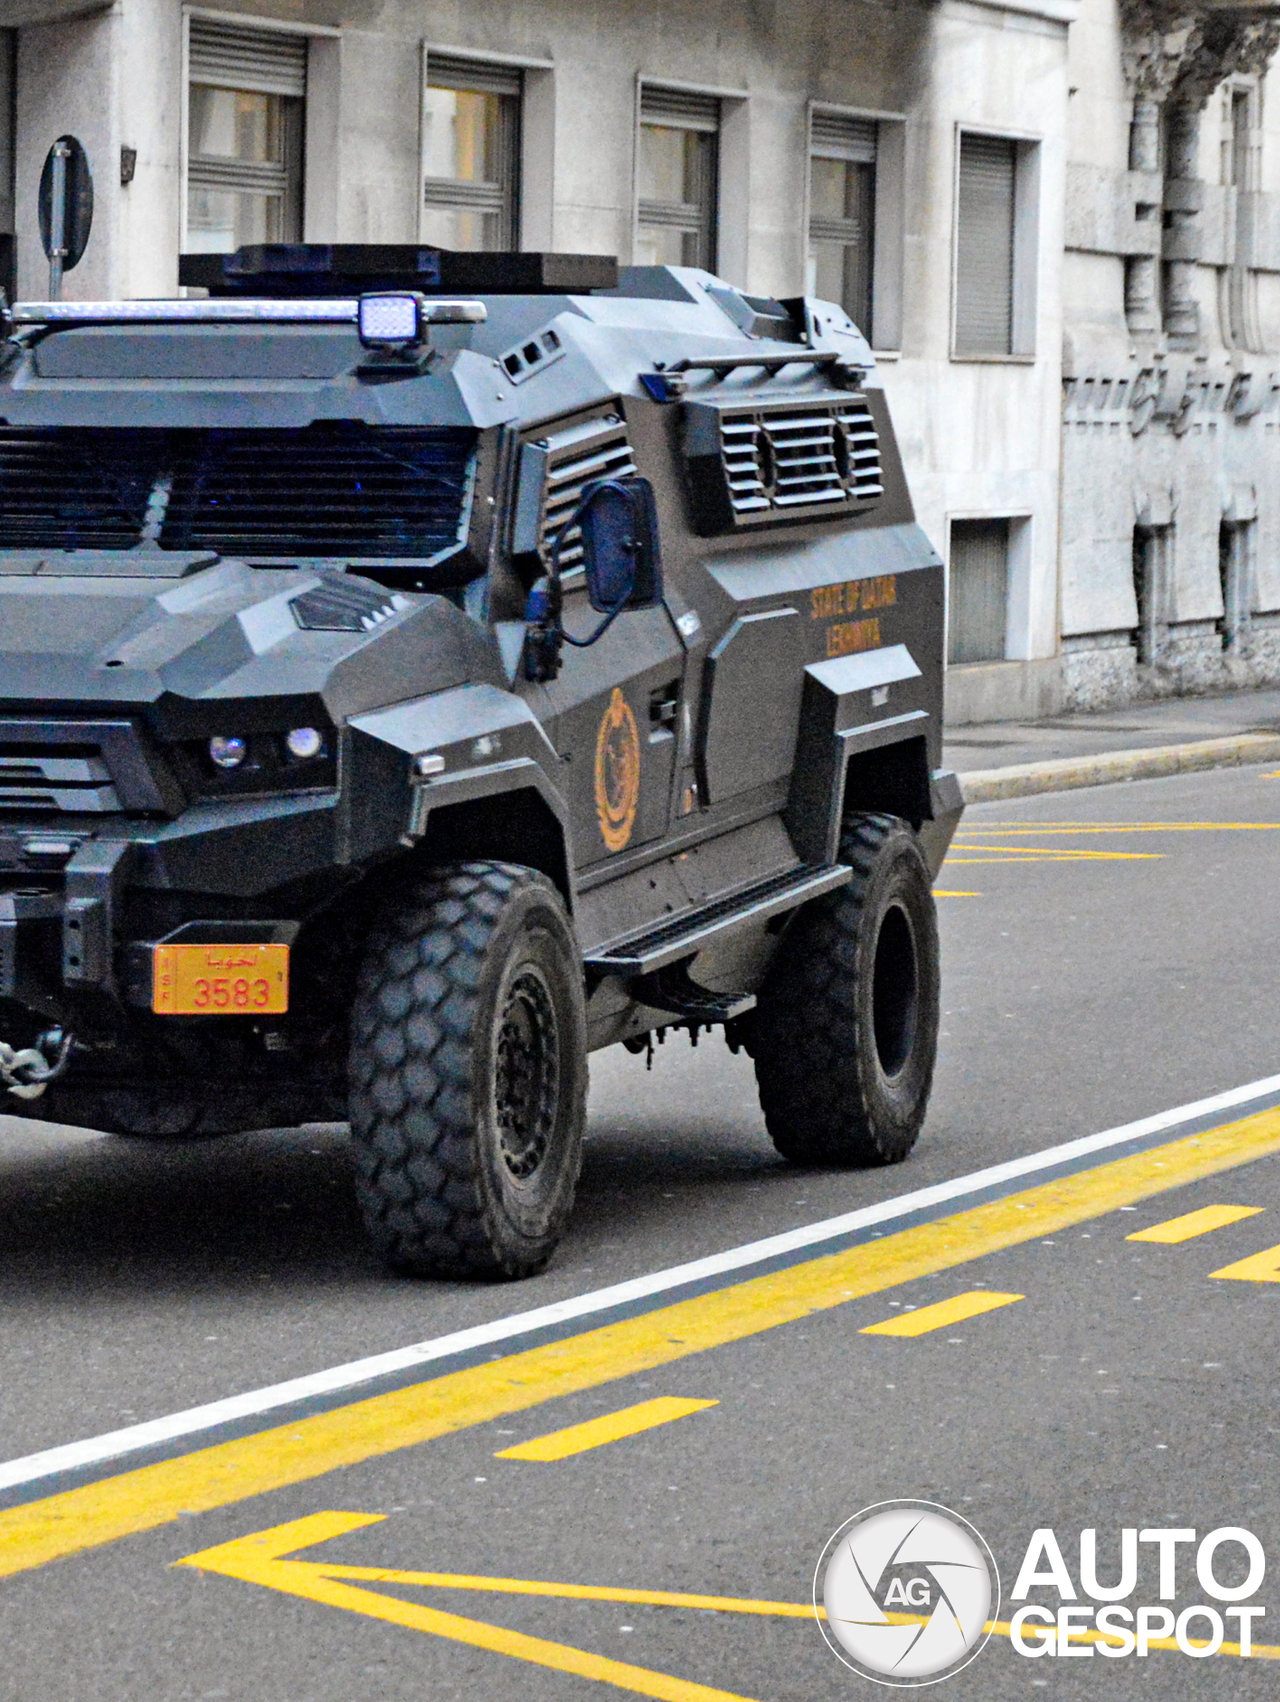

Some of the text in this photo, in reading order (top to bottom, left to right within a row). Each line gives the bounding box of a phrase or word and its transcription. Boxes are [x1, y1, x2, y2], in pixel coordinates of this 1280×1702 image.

[811, 585, 844, 619] STATE
[846, 581, 860, 613] OF
[194, 978, 269, 1008] 3583
